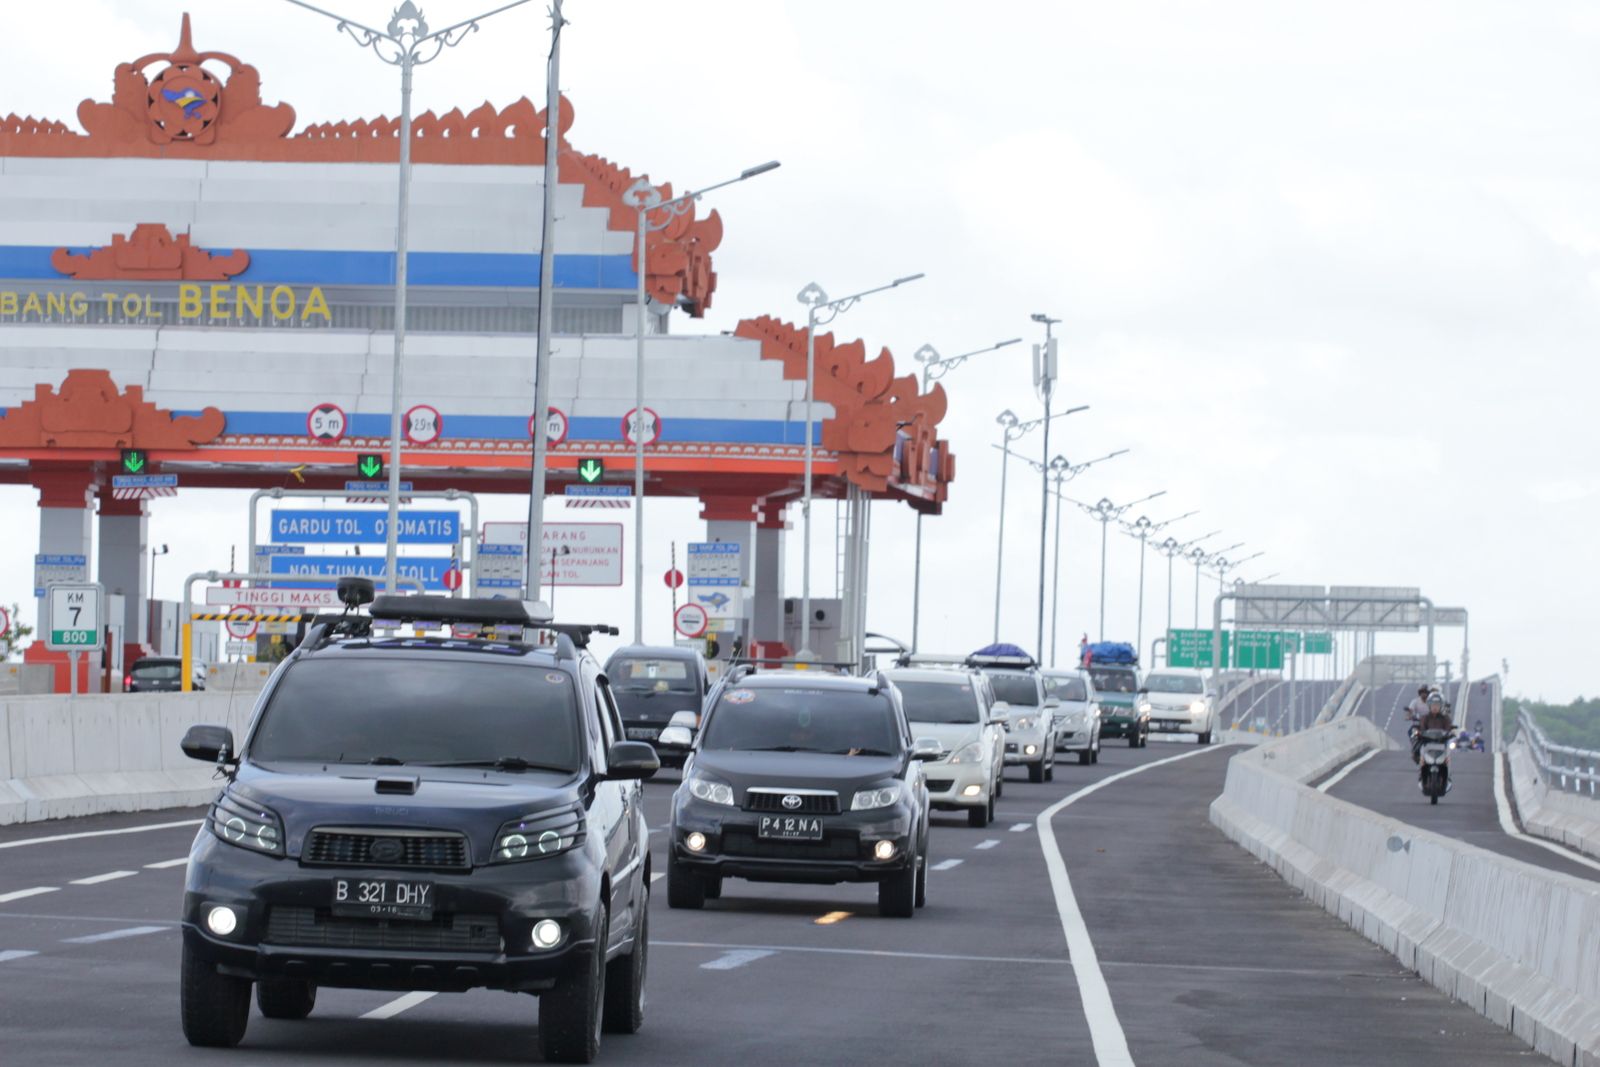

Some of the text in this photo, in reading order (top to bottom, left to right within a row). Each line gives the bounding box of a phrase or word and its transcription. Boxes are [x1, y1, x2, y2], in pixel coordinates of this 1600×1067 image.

[0, 283, 332, 320] BANG TOL BENOA
[315, 417, 339, 429] 5 m
[549, 422, 560, 433] m
[279, 518, 330, 534] GARDU
[336, 519, 362, 535] TOL
[520, 531, 586, 541] DARANG
[67, 592, 84, 603] KM
[235, 591, 284, 603] TINGGI
[69, 606, 82, 627] 7
[63, 631, 87, 643] 800
[336, 880, 430, 904] B 321 DHY
